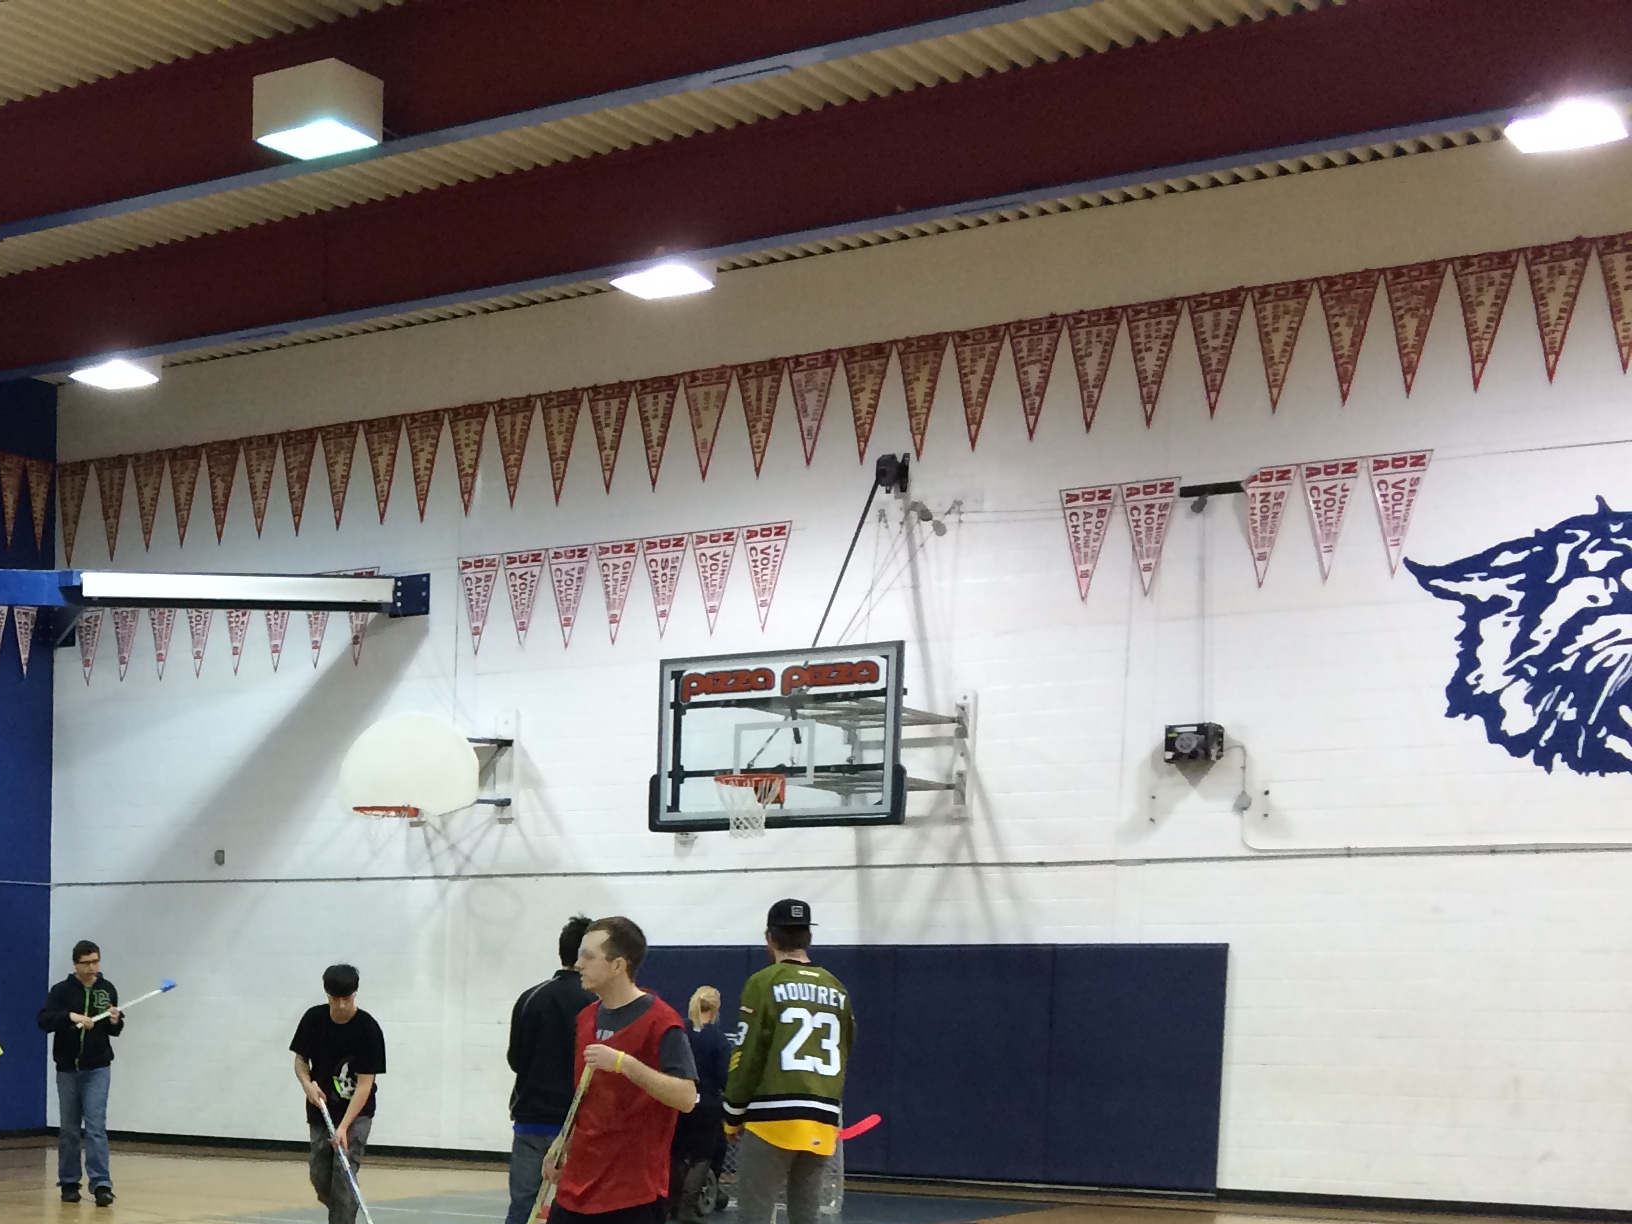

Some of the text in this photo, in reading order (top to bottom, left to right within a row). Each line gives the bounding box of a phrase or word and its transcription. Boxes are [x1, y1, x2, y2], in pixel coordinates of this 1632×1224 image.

[1305, 461, 1358, 479] NDA
[1372, 454, 1427, 472] NDA
[1066, 488, 1112, 504] NDA
[1126, 481, 1174, 498] NDA
[1334, 483, 1351, 530] JUNIOR
[1402, 477, 1421, 523] SENIOR
[1259, 492, 1272, 533] NORDIC
[1268, 491, 1286, 534] SENIOR
[1082, 511, 1093, 549] ALPINE
[1092, 508, 1108, 543] BOYS
[1154, 502, 1170, 545] SENIOR
[695, 531, 735, 546] NDA
[746, 525, 787, 540] NDA
[598, 542, 635, 557] NDA
[646, 538, 684, 552] NDA
[1322, 545, 1334, 553] 11
[1389, 538, 1401, 547] 11
[506, 553, 542, 566] NDA
[552, 547, 588, 560] NDA
[1257, 552, 1268, 562] 10
[462, 557, 497, 571] NDA
[768, 544, 781, 589] JUNIOR
[1142, 563, 1152, 573] 10
[618, 561, 632, 592] GIRLS
[660, 558, 670, 605] SOCCER
[667, 556, 680, 593] SENIOR
[1079, 569, 1090, 579] 10
[707, 606, 717, 614] 10
[759, 599, 769, 608] 10
[659, 609, 668, 618] 10
[680, 660, 880, 704] pizza pizza
[772, 982, 846, 1010] MOUTREY
[779, 1007, 841, 1076] 23
